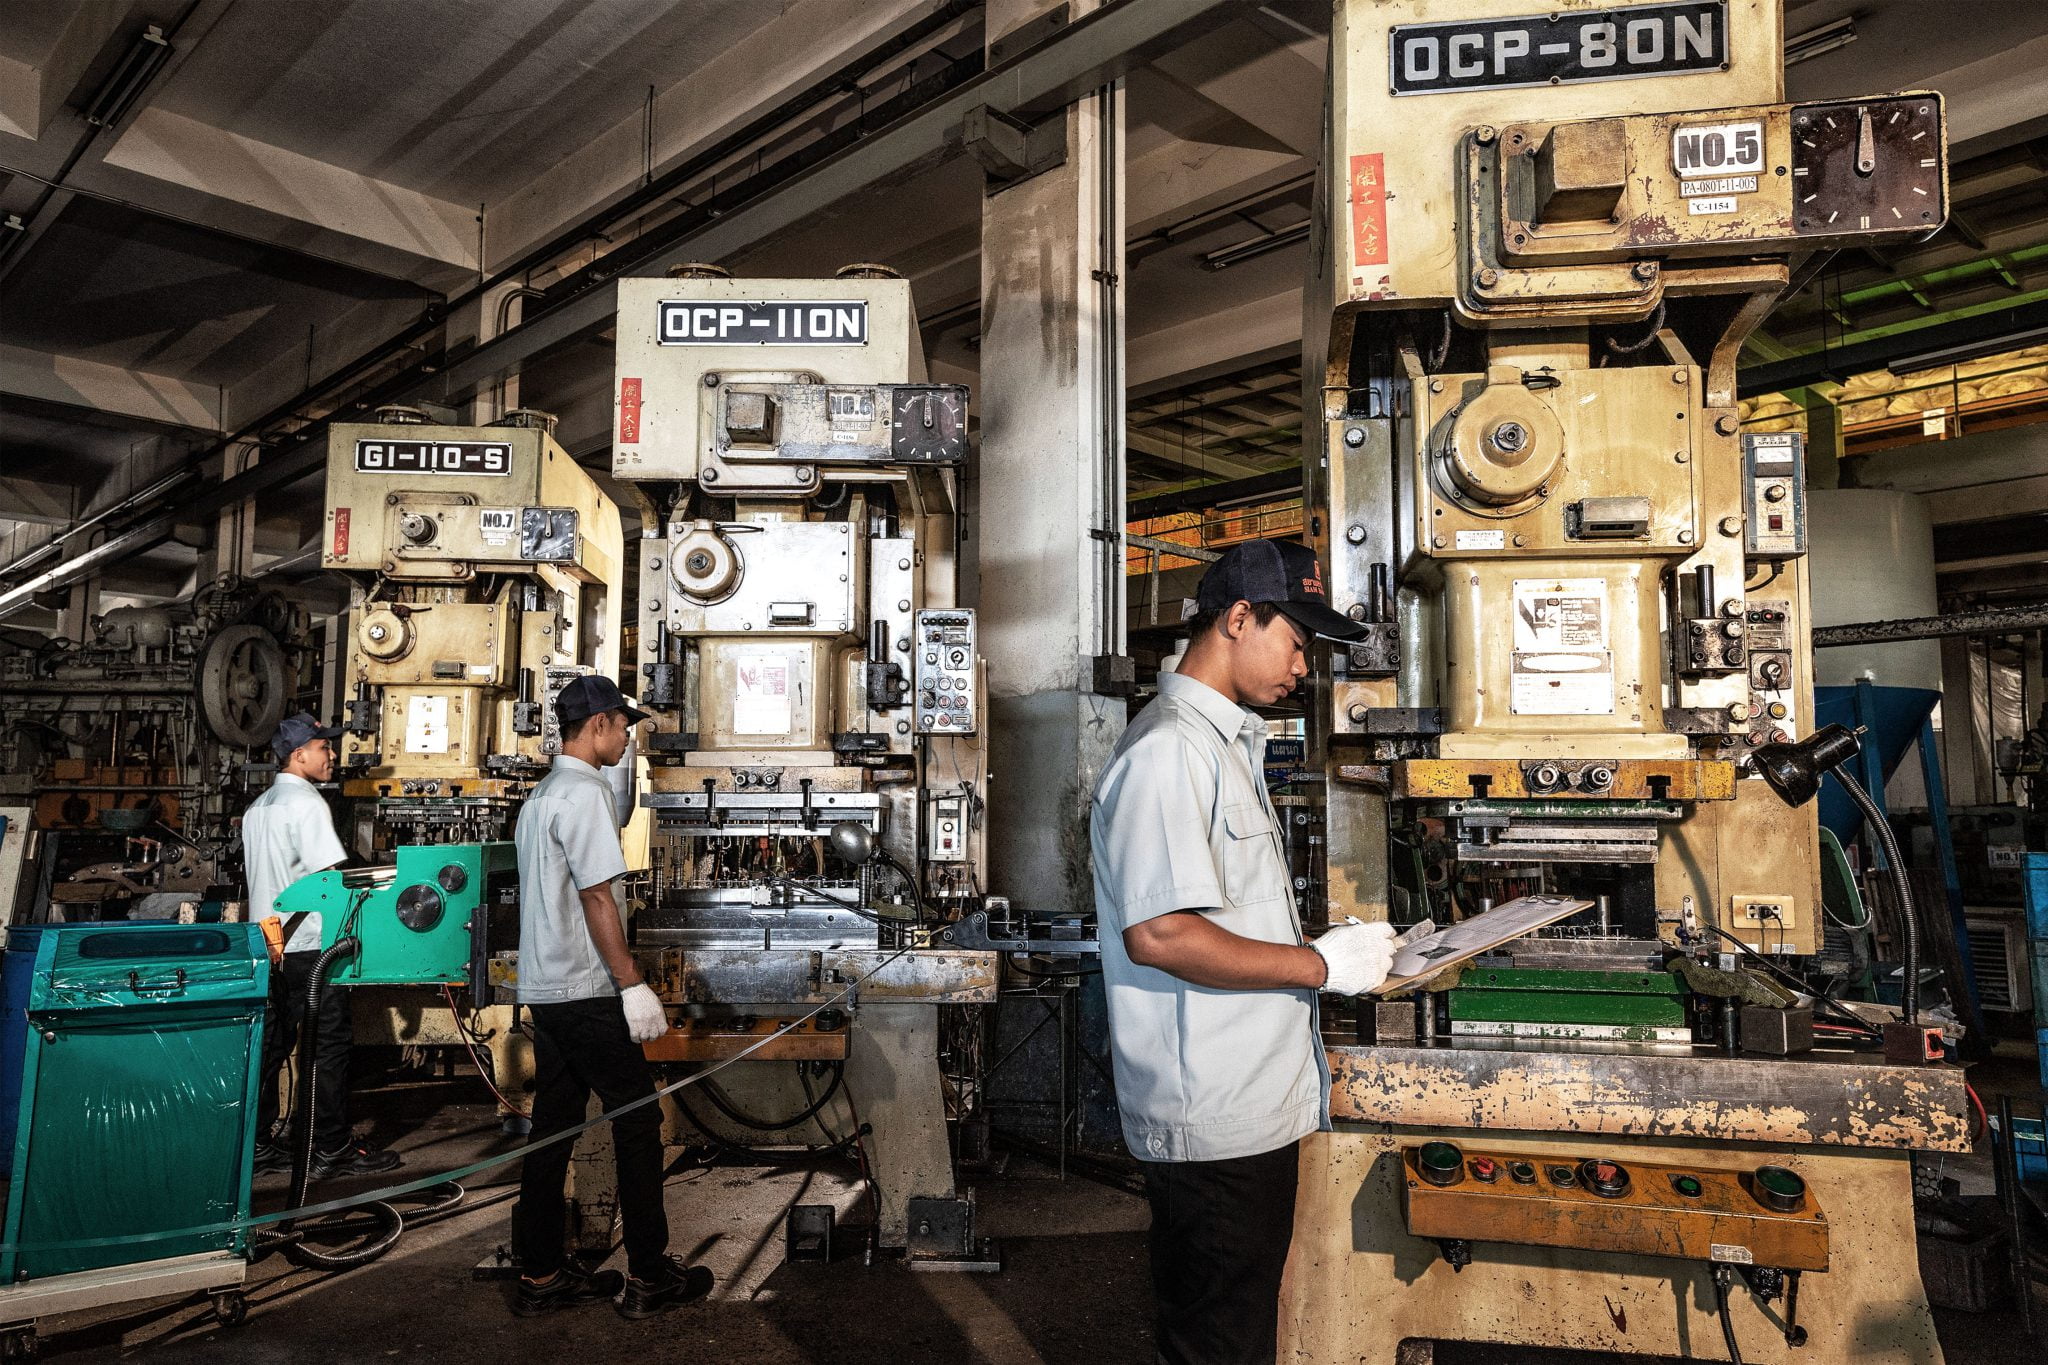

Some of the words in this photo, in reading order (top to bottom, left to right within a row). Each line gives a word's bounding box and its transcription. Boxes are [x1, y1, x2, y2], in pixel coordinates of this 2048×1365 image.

[1403, 12, 1714, 82] OCP-80N
[1678, 130, 1759, 169] NO.5
[1356, 165, 1379, 256] 開工大吉
[665, 307, 860, 338] OCP-110N
[482, 513, 514, 528] NO.7
